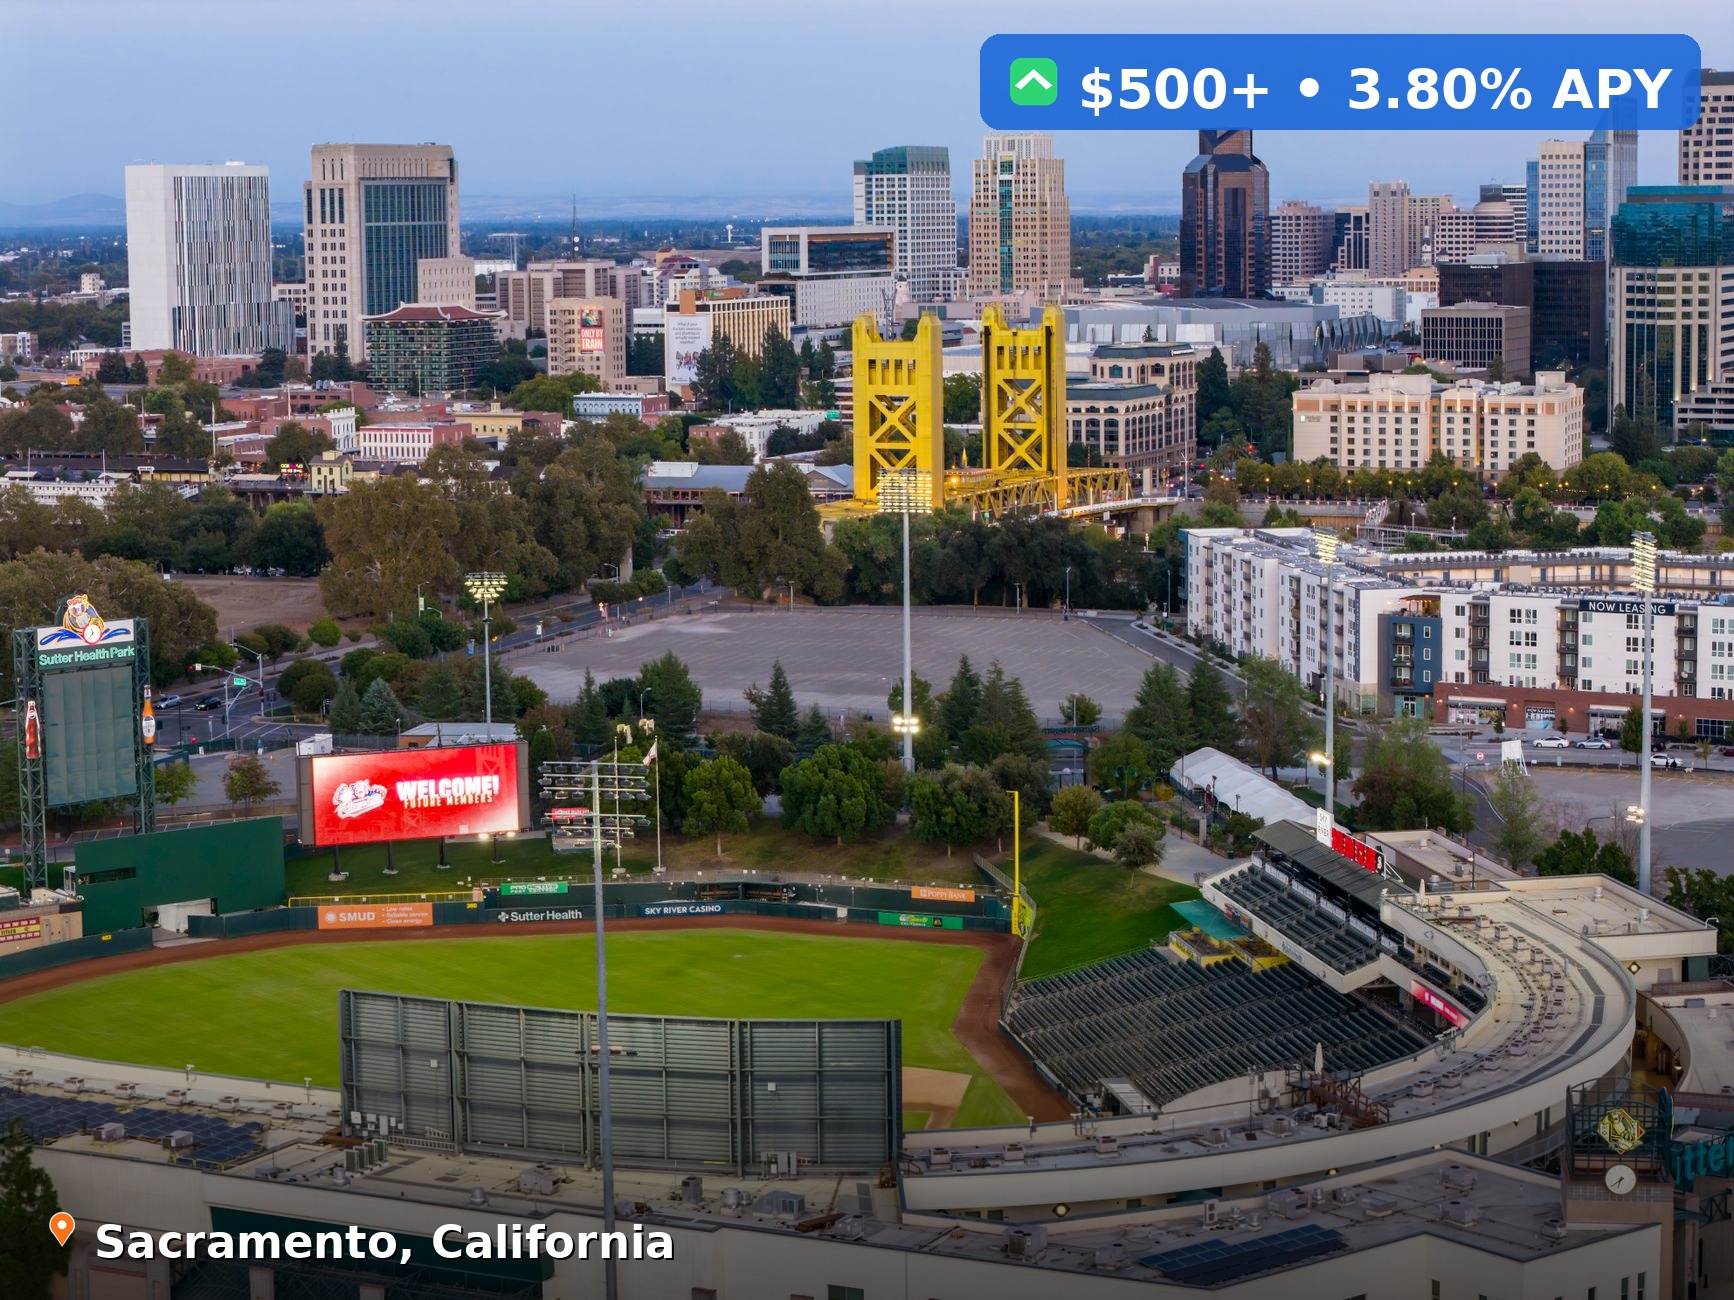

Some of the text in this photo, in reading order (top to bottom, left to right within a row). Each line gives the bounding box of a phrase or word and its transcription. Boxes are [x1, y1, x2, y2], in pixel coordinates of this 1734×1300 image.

[581, 338, 603, 349] TRAIN
[1588, 602, 1666, 614] NOW LEASNG
[39, 645, 135, 666] Sutter Health Park
[396, 775, 500, 800] WELCOME!
[404, 793, 493, 809] FUTURE MEMBERS
[510, 909, 582, 921] Sutter Health
[645, 905, 721, 915] SKY RIVER CASINO
[339, 911, 375, 922] SMUD
